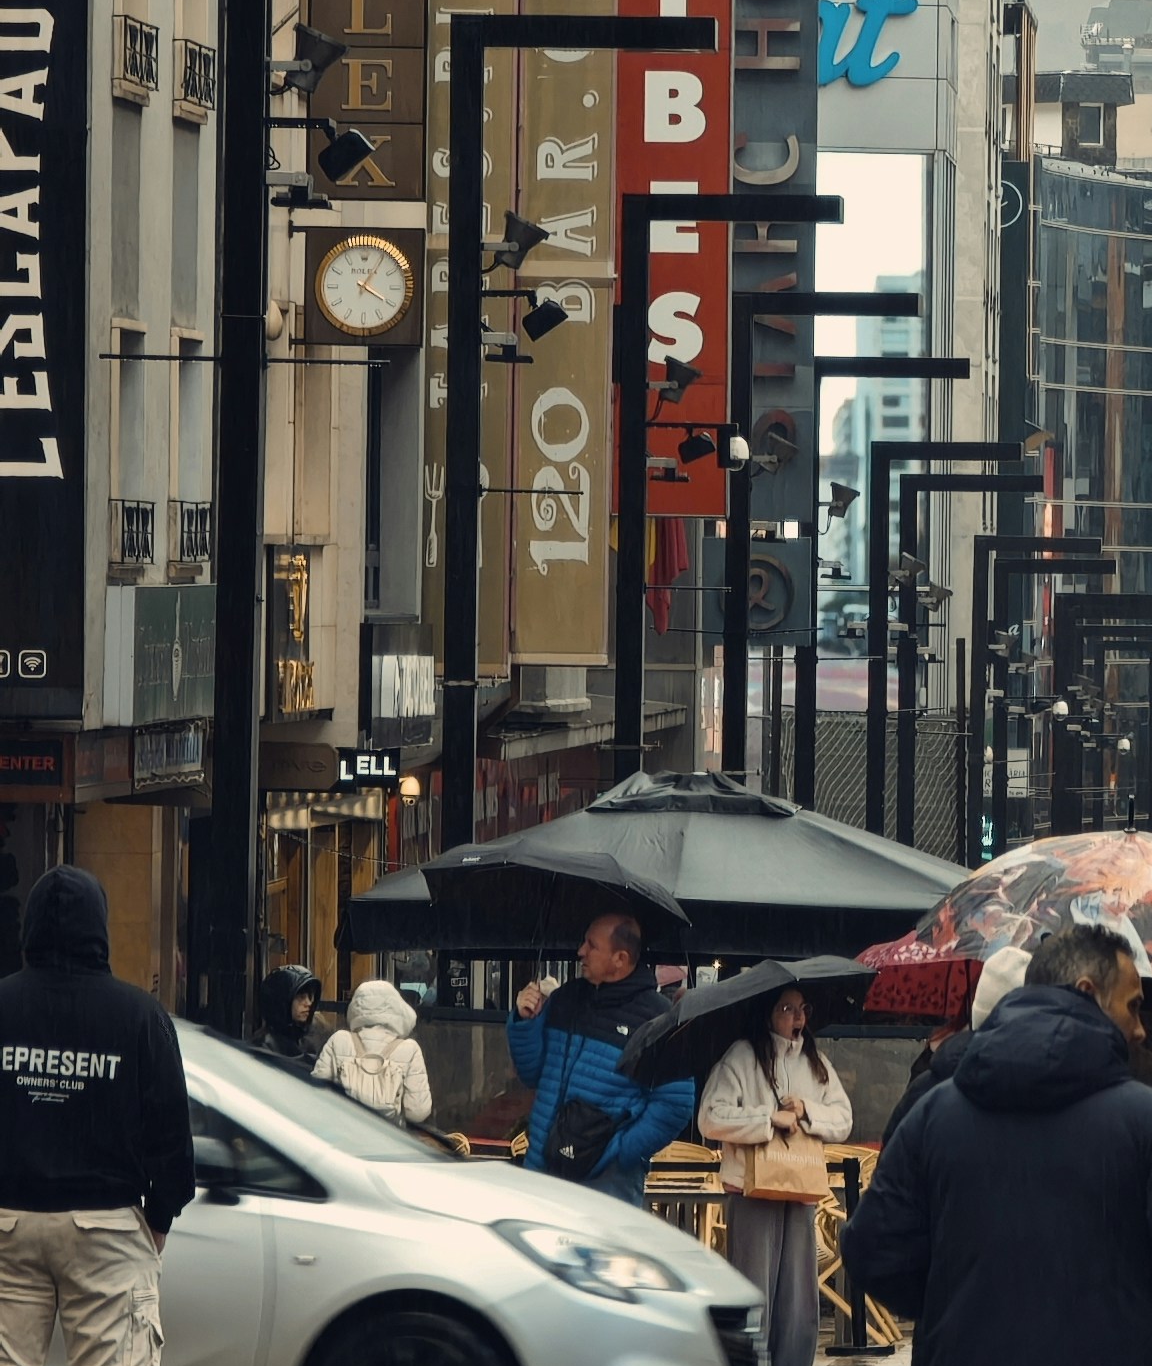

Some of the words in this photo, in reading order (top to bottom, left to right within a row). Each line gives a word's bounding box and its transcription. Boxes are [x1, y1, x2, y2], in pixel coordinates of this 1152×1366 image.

[527, 385, 591, 577] 120
[2, 1046, 122, 1080] EPRESENT
[59, 1079, 85, 1091] CLUB
